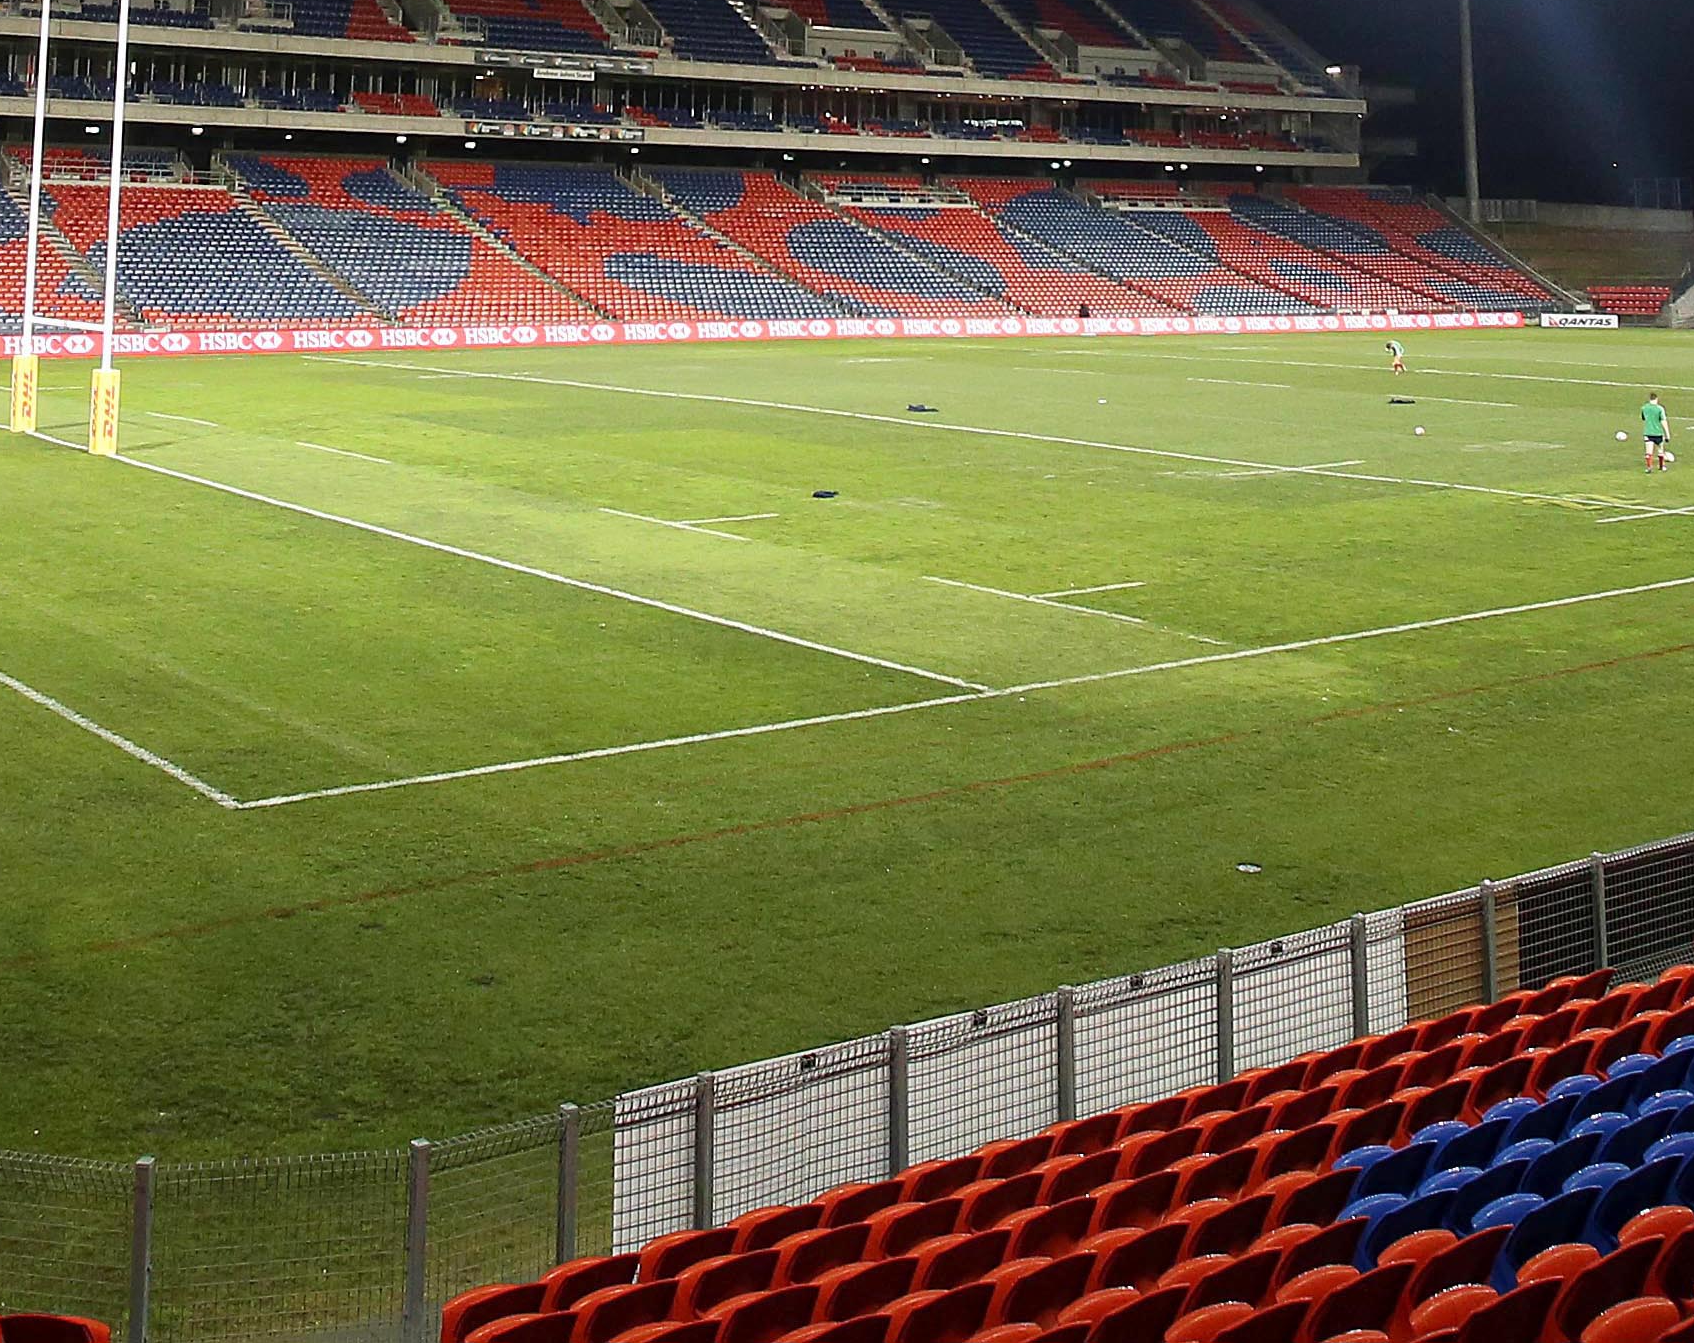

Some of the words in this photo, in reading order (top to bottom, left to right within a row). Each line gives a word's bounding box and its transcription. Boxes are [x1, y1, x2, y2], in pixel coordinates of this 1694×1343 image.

[1558, 317, 1612, 327] QANTAS
[3, 336, 62, 355] HBC
[199, 332, 252, 350] HSBC
[293, 330, 345, 348] HSBC
[380, 329, 431, 346] HSBC
[464, 327, 512, 344] HSBC
[544, 325, 591, 343] HSBC
[623, 323, 667, 340] HSBC
[697, 322, 740, 338] HSBC
[768, 321, 807, 337] HSBC
[835, 319, 875, 335] HSBC
[903, 319, 941, 335] HSBC
[966, 318, 1003, 334] HSBC
